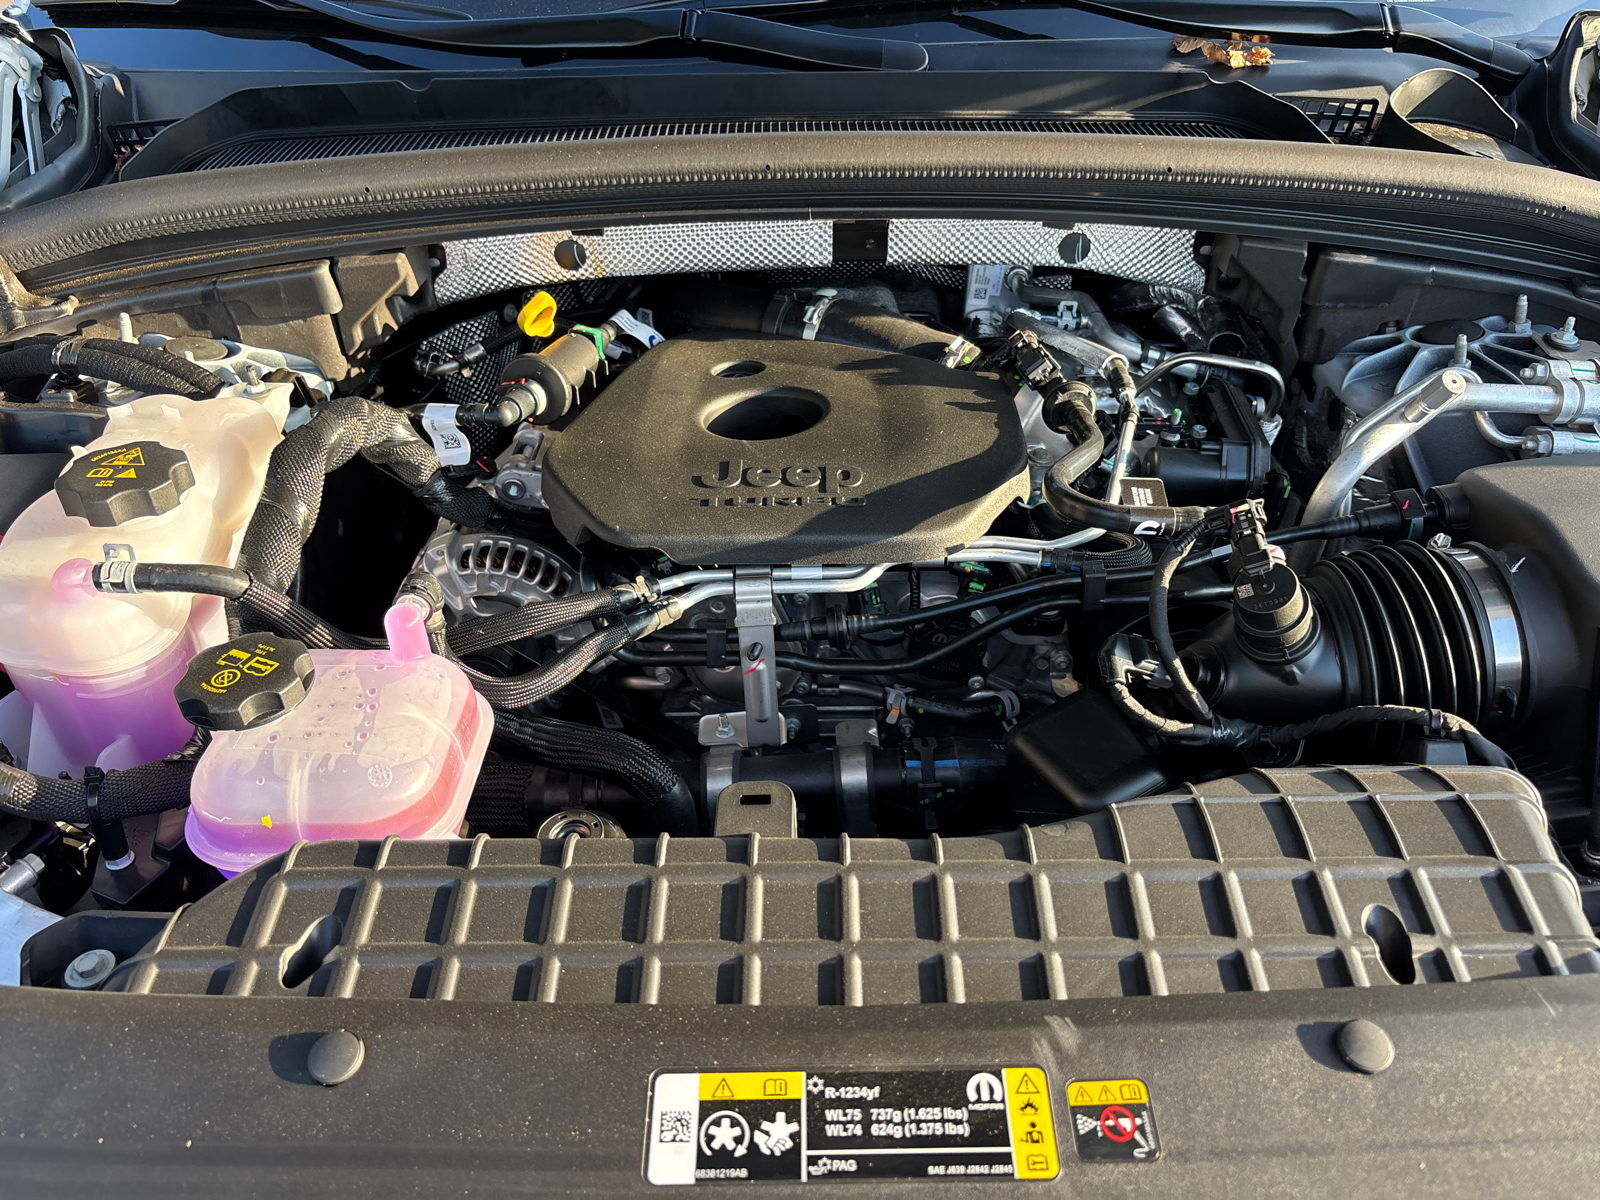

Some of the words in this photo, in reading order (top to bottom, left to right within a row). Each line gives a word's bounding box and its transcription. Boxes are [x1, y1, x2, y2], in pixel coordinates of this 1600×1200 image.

[691, 459, 864, 494] Jeep
[689, 496, 867, 507] TURBO
[824, 1086, 881, 1101] R-1234yf
[968, 1102, 1005, 1111] MOPAR
[824, 1108, 863, 1121] WL75
[869, 1108, 903, 1123] 737g
[903, 1107, 943, 1122] (1.625
[943, 1106, 969, 1121] lbs)
[824, 1123, 864, 1137] WL74
[870, 1123, 904, 1138] 624g
[904, 1122, 944, 1138] (1.375
[944, 1121, 971, 1137] lbs)
[832, 1159, 858, 1171] PAG
